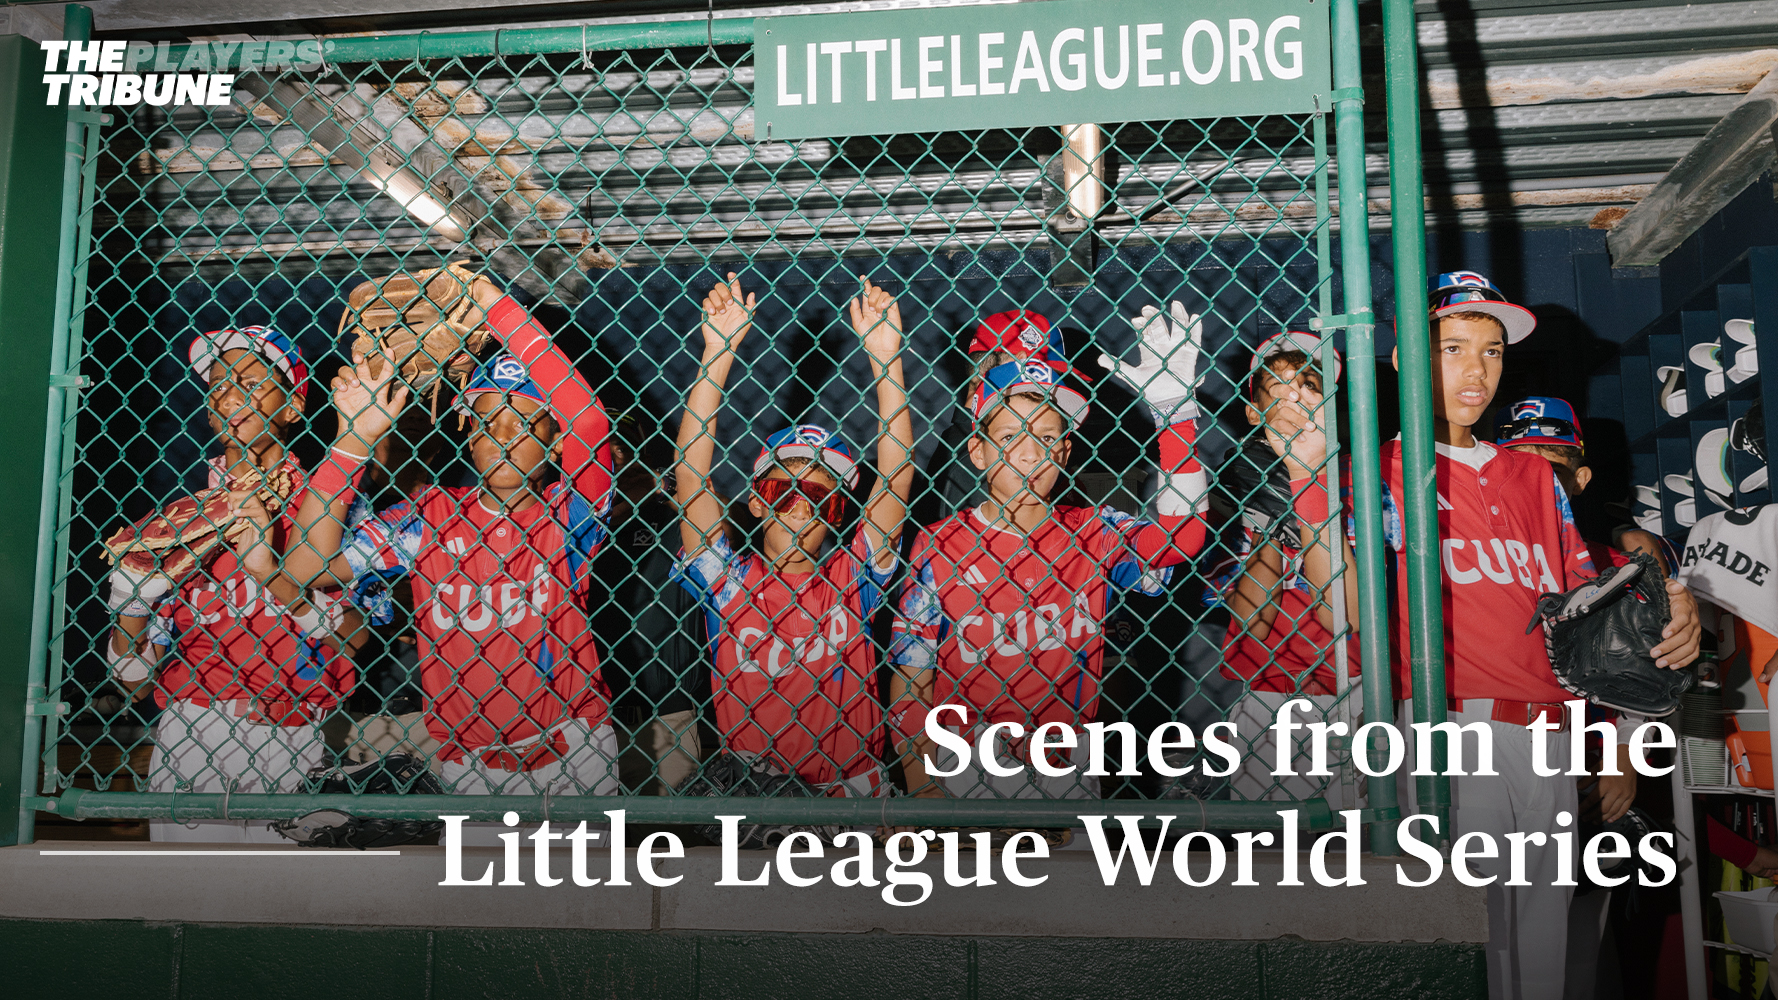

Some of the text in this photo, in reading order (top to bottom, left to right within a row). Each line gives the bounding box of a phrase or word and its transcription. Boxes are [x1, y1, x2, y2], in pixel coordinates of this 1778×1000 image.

[777, 15, 1303, 106] LITTLELEAGUE.ORG
[432, 563, 550, 632] CUBA
[1442, 537, 1560, 593] CUBA
[957, 591, 1101, 664] CUBA
